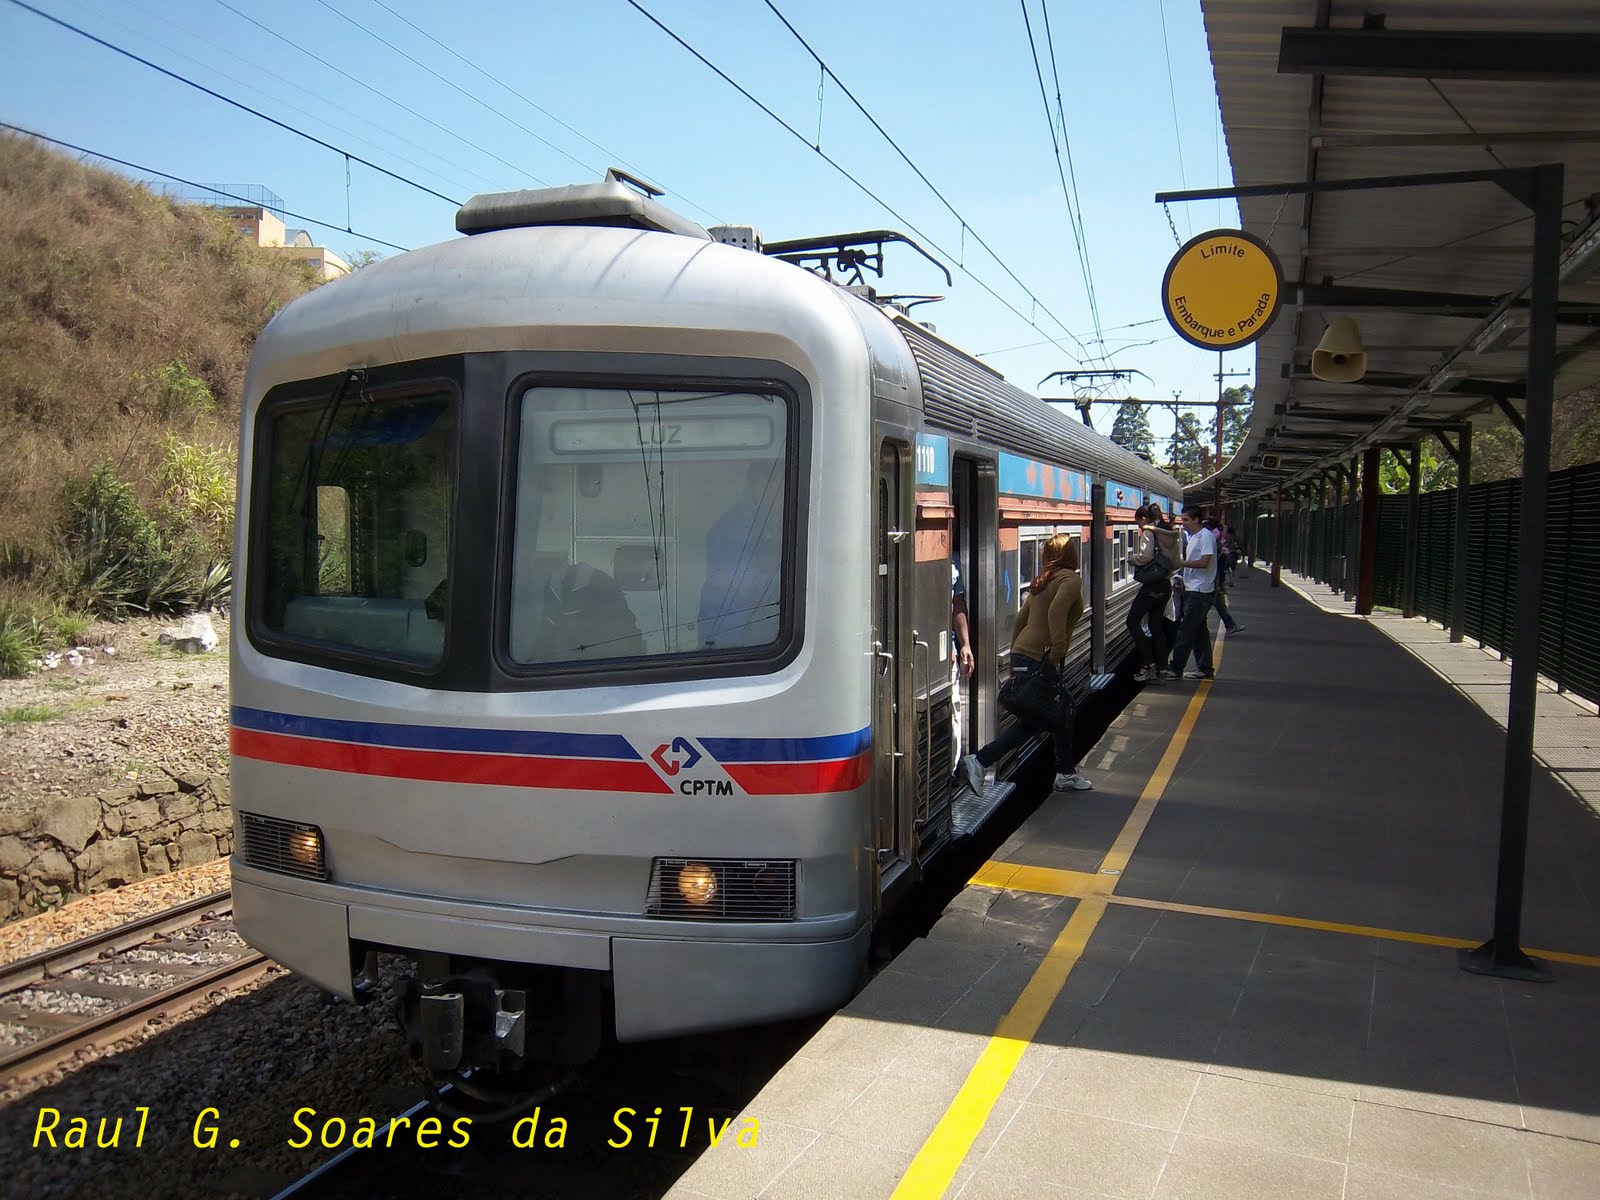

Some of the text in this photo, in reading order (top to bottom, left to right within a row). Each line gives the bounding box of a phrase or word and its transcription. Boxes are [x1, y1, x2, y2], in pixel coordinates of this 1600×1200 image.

[1200, 243, 1246, 259] Limite
[1174, 292, 1271, 338] Embarque e Parada
[636, 424, 683, 446] LUZ
[916, 444, 935, 474] 1110
[679, 779, 734, 796] CPTM
